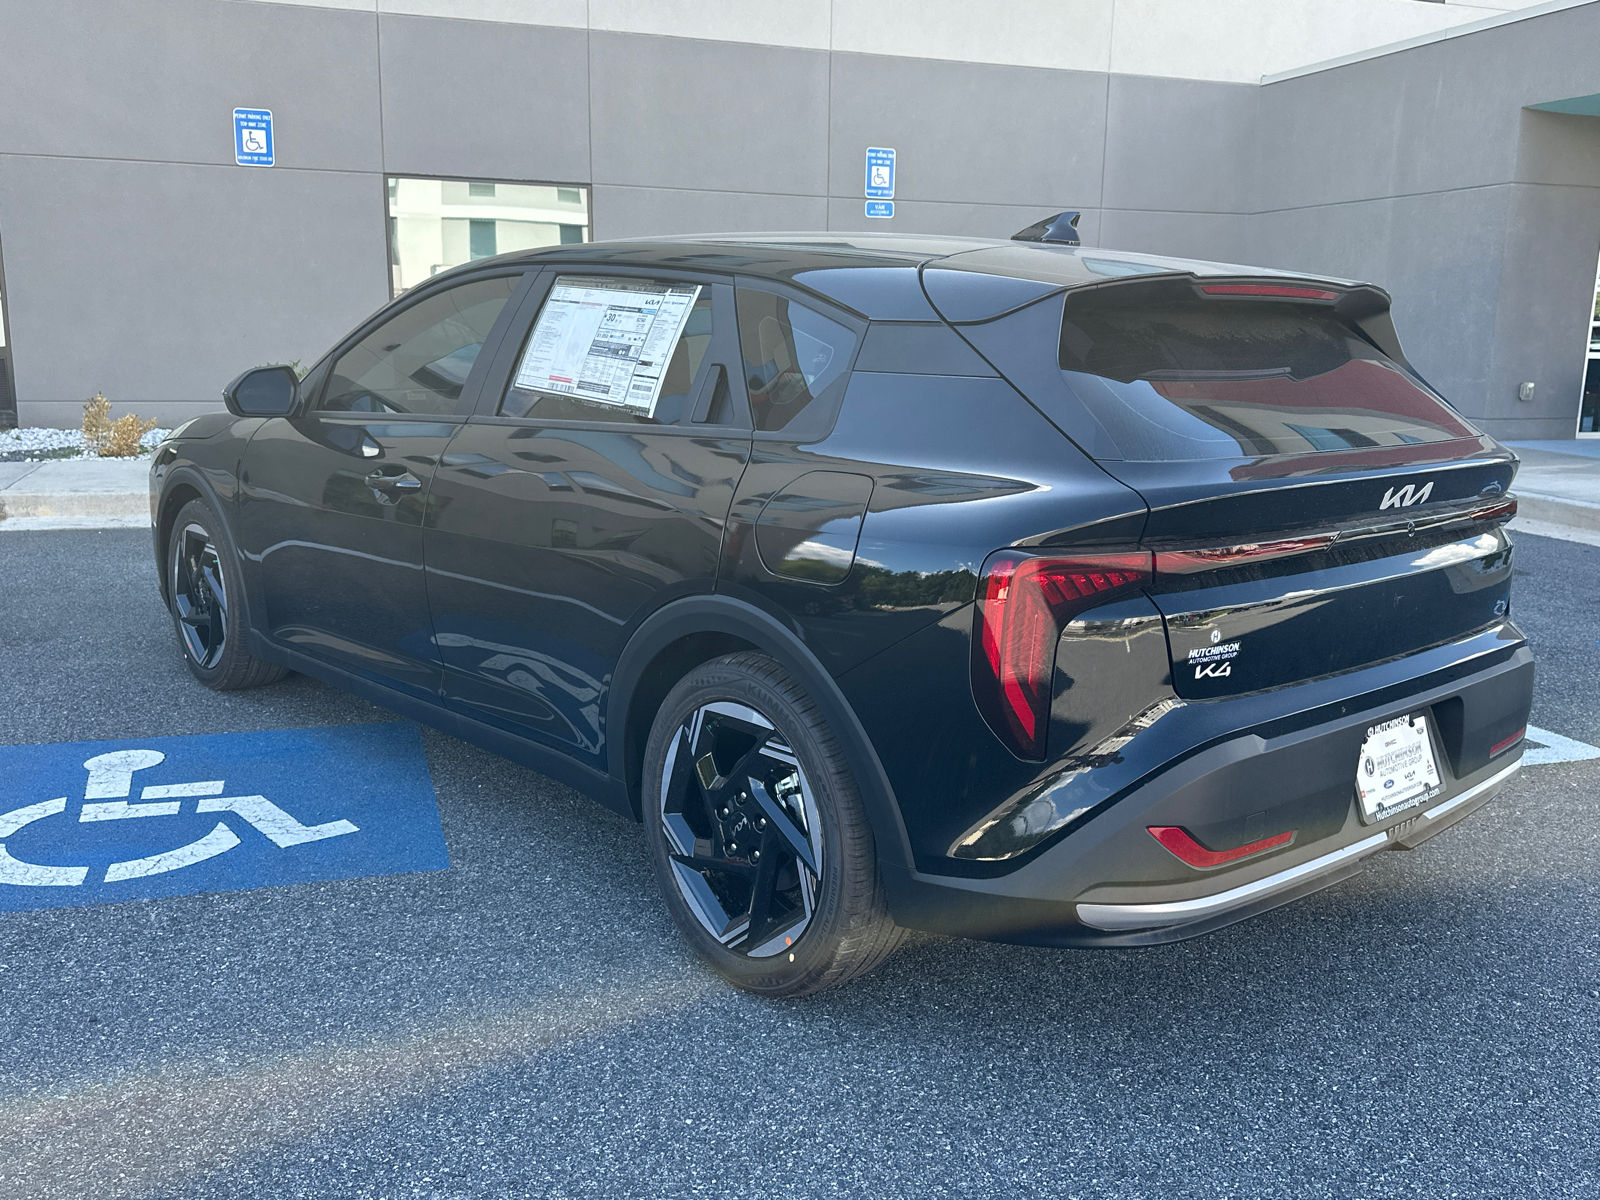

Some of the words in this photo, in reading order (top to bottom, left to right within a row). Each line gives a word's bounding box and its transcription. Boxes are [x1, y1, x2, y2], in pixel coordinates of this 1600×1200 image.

[1379, 482, 1434, 510] KIA
[1188, 642, 1240, 659] HUTCHINSON
[1188, 654, 1221, 664] AUTOMOTIVE
[1222, 652, 1238, 660] GROUP
[1194, 662, 1232, 680] K4
[747, 681, 798, 734] KUMHO
[1375, 714, 1410, 734] HUTCHINSON
[1376, 740, 1423, 770] HUTCHINSON
[1380, 760, 1408, 778] AUTOMOTIVE
[1408, 754, 1422, 766] GROUP
[825, 866, 839, 917] PREMIUM
